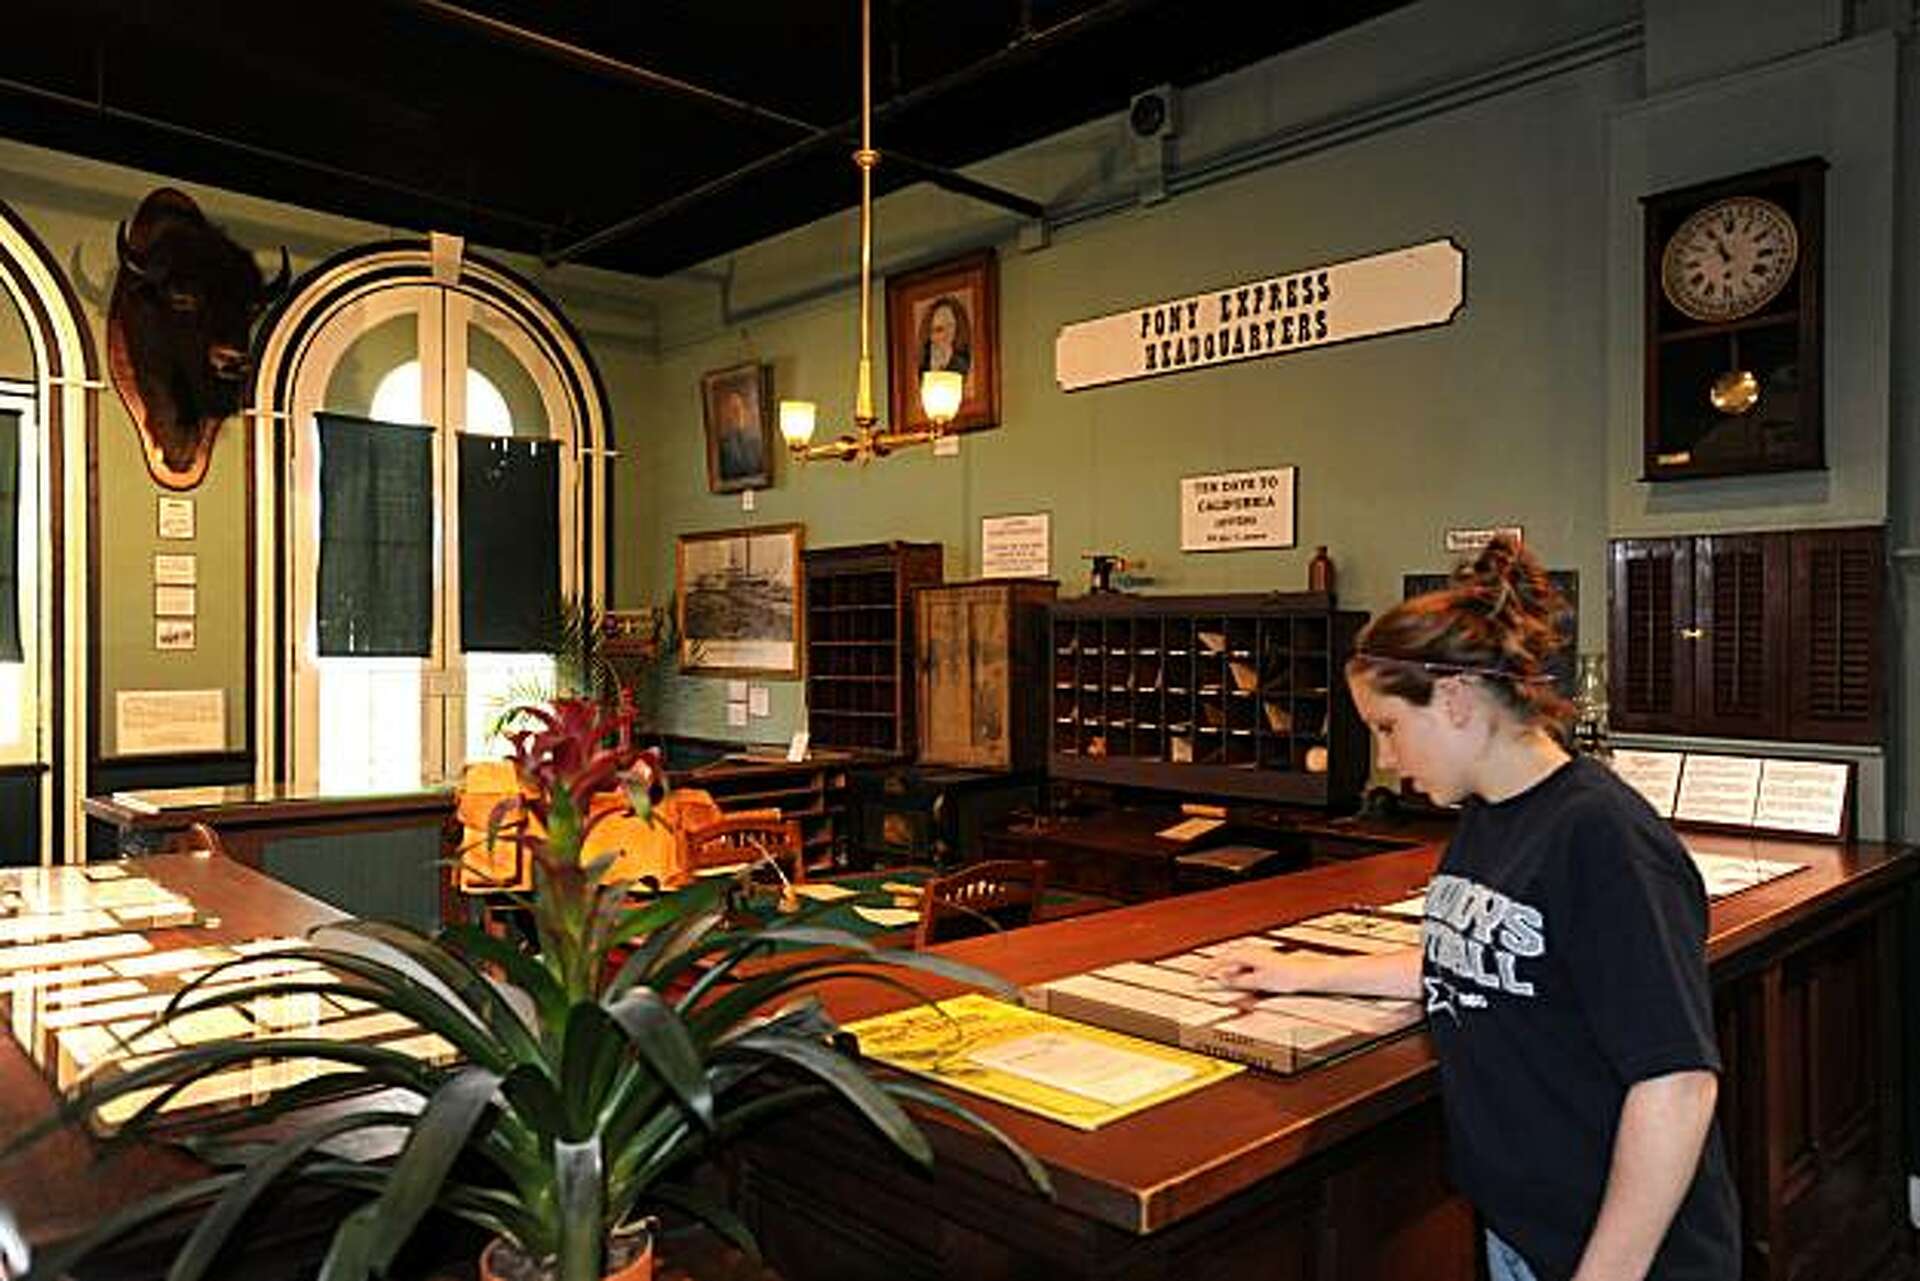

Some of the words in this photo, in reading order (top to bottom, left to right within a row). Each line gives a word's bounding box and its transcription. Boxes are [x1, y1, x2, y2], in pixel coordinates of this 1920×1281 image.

[1141, 301, 1198, 339] PONY
[1219, 273, 1330, 322] EXPRESS
[1145, 309, 1327, 370] HEADQUARTERS
